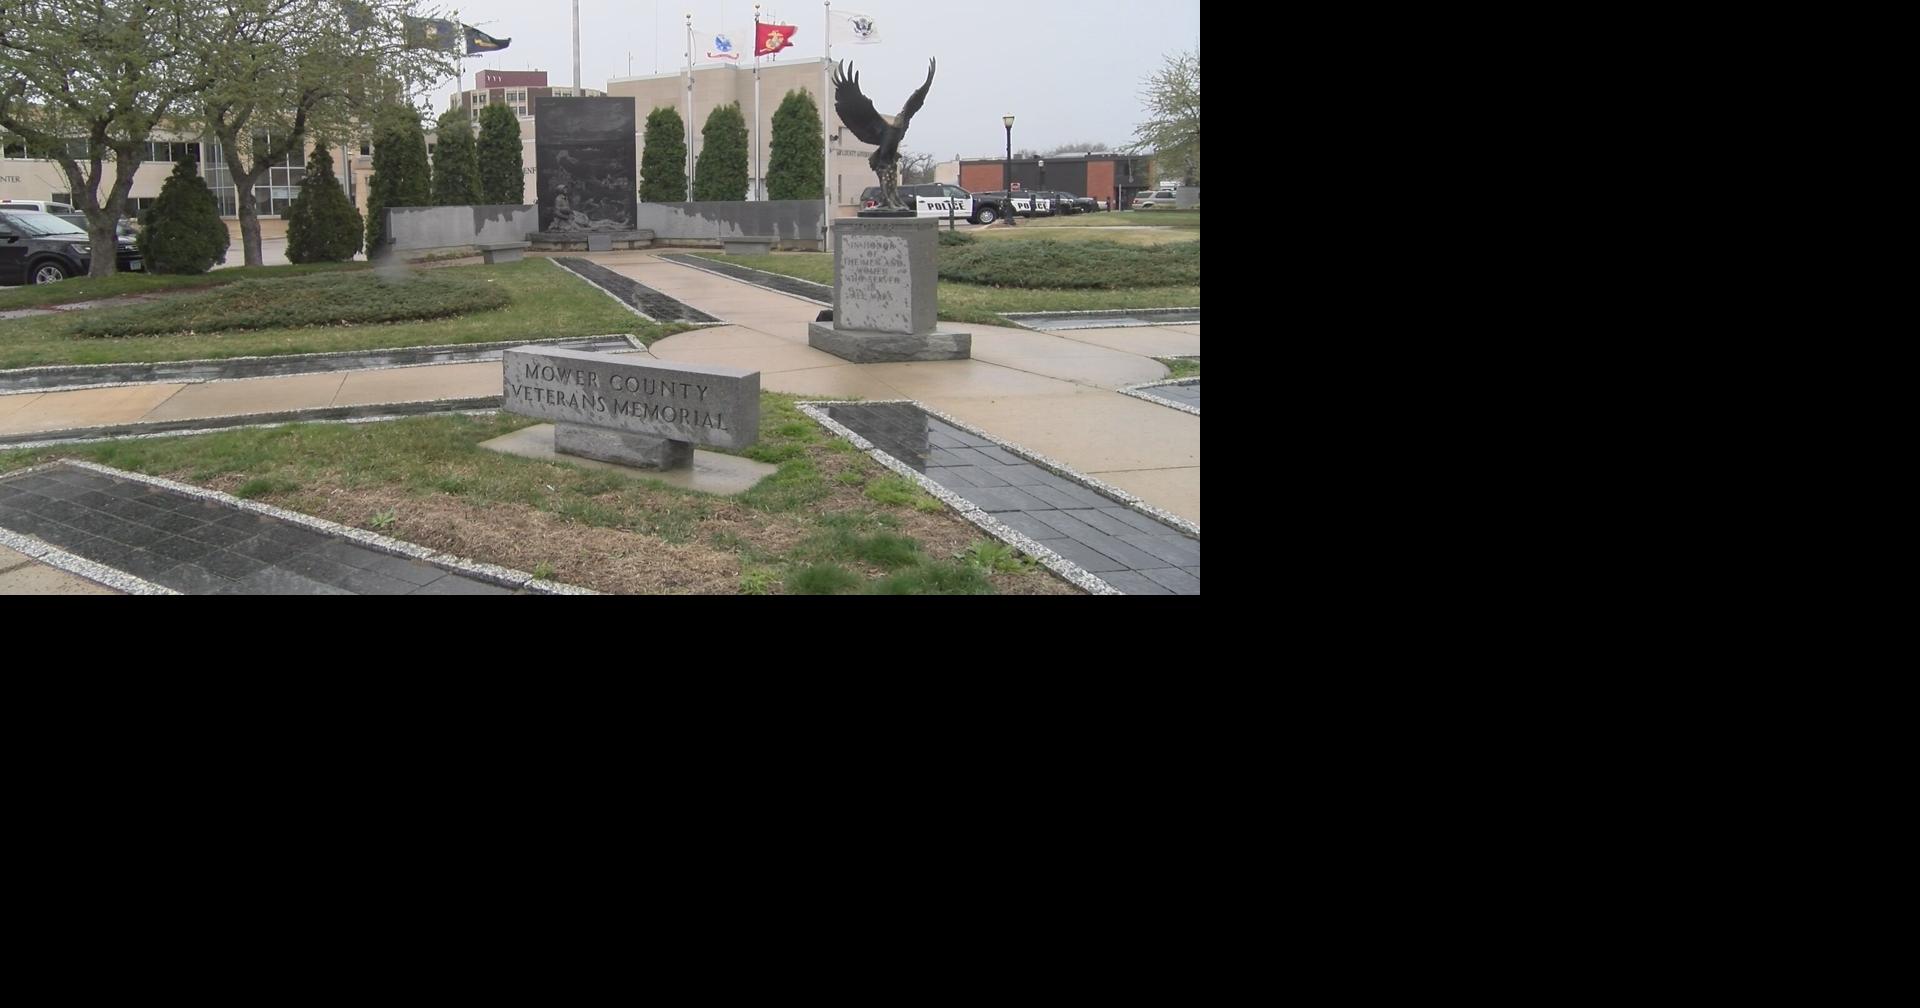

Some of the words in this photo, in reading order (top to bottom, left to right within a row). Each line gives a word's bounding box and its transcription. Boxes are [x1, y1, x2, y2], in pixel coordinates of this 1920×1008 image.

[927, 202, 966, 211] POLICE
[1018, 202, 1047, 210] POCE
[525, 364, 598, 387] MOWER
[610, 374, 709, 401] COUNTY
[511, 384, 606, 413] VETERANS
[614, 399, 728, 431] MEMORIAL
